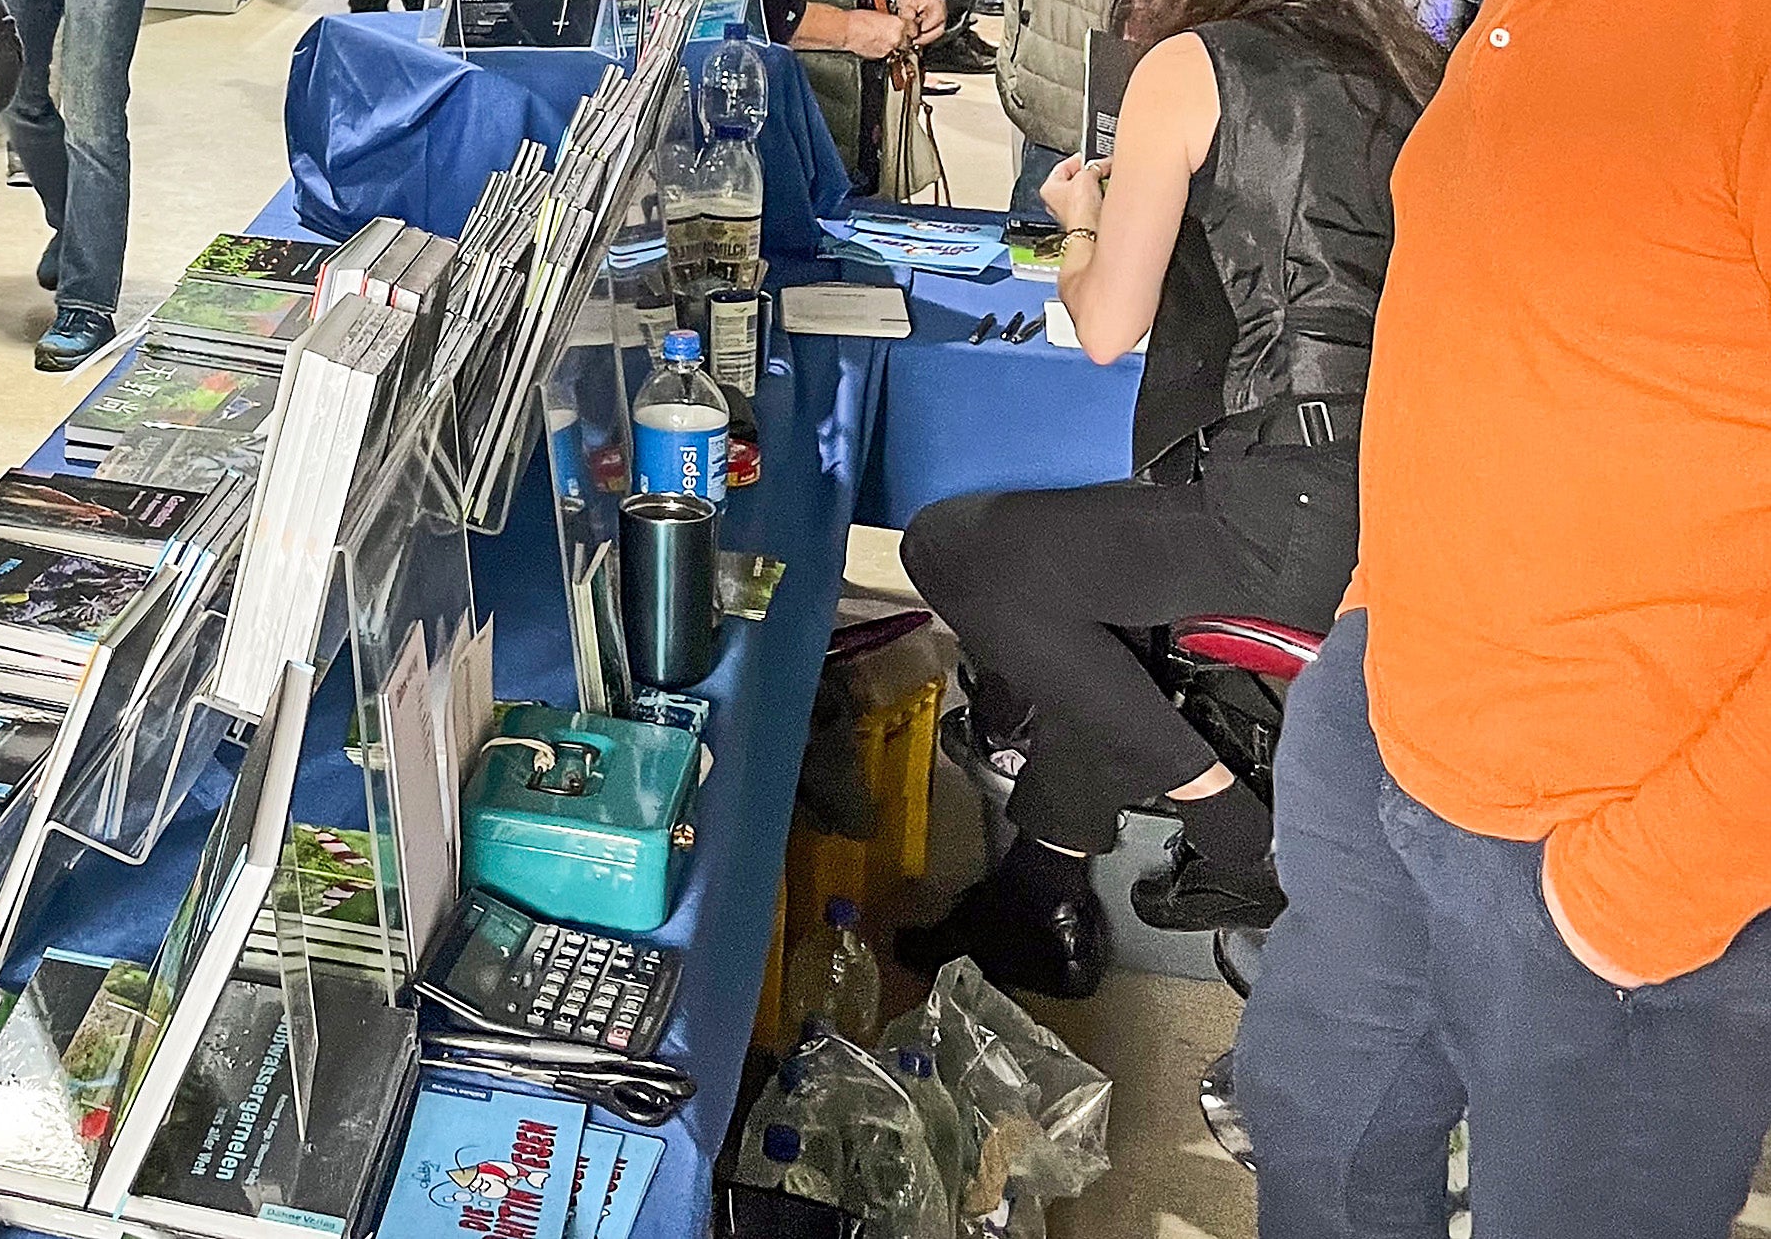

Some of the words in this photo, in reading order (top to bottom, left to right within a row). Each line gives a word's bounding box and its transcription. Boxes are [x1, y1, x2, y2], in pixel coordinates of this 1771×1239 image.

[190, 1152, 213, 1176] Welt
[458, 1205, 495, 1232] DIE
[482, 1187, 545, 1239] HITIN
